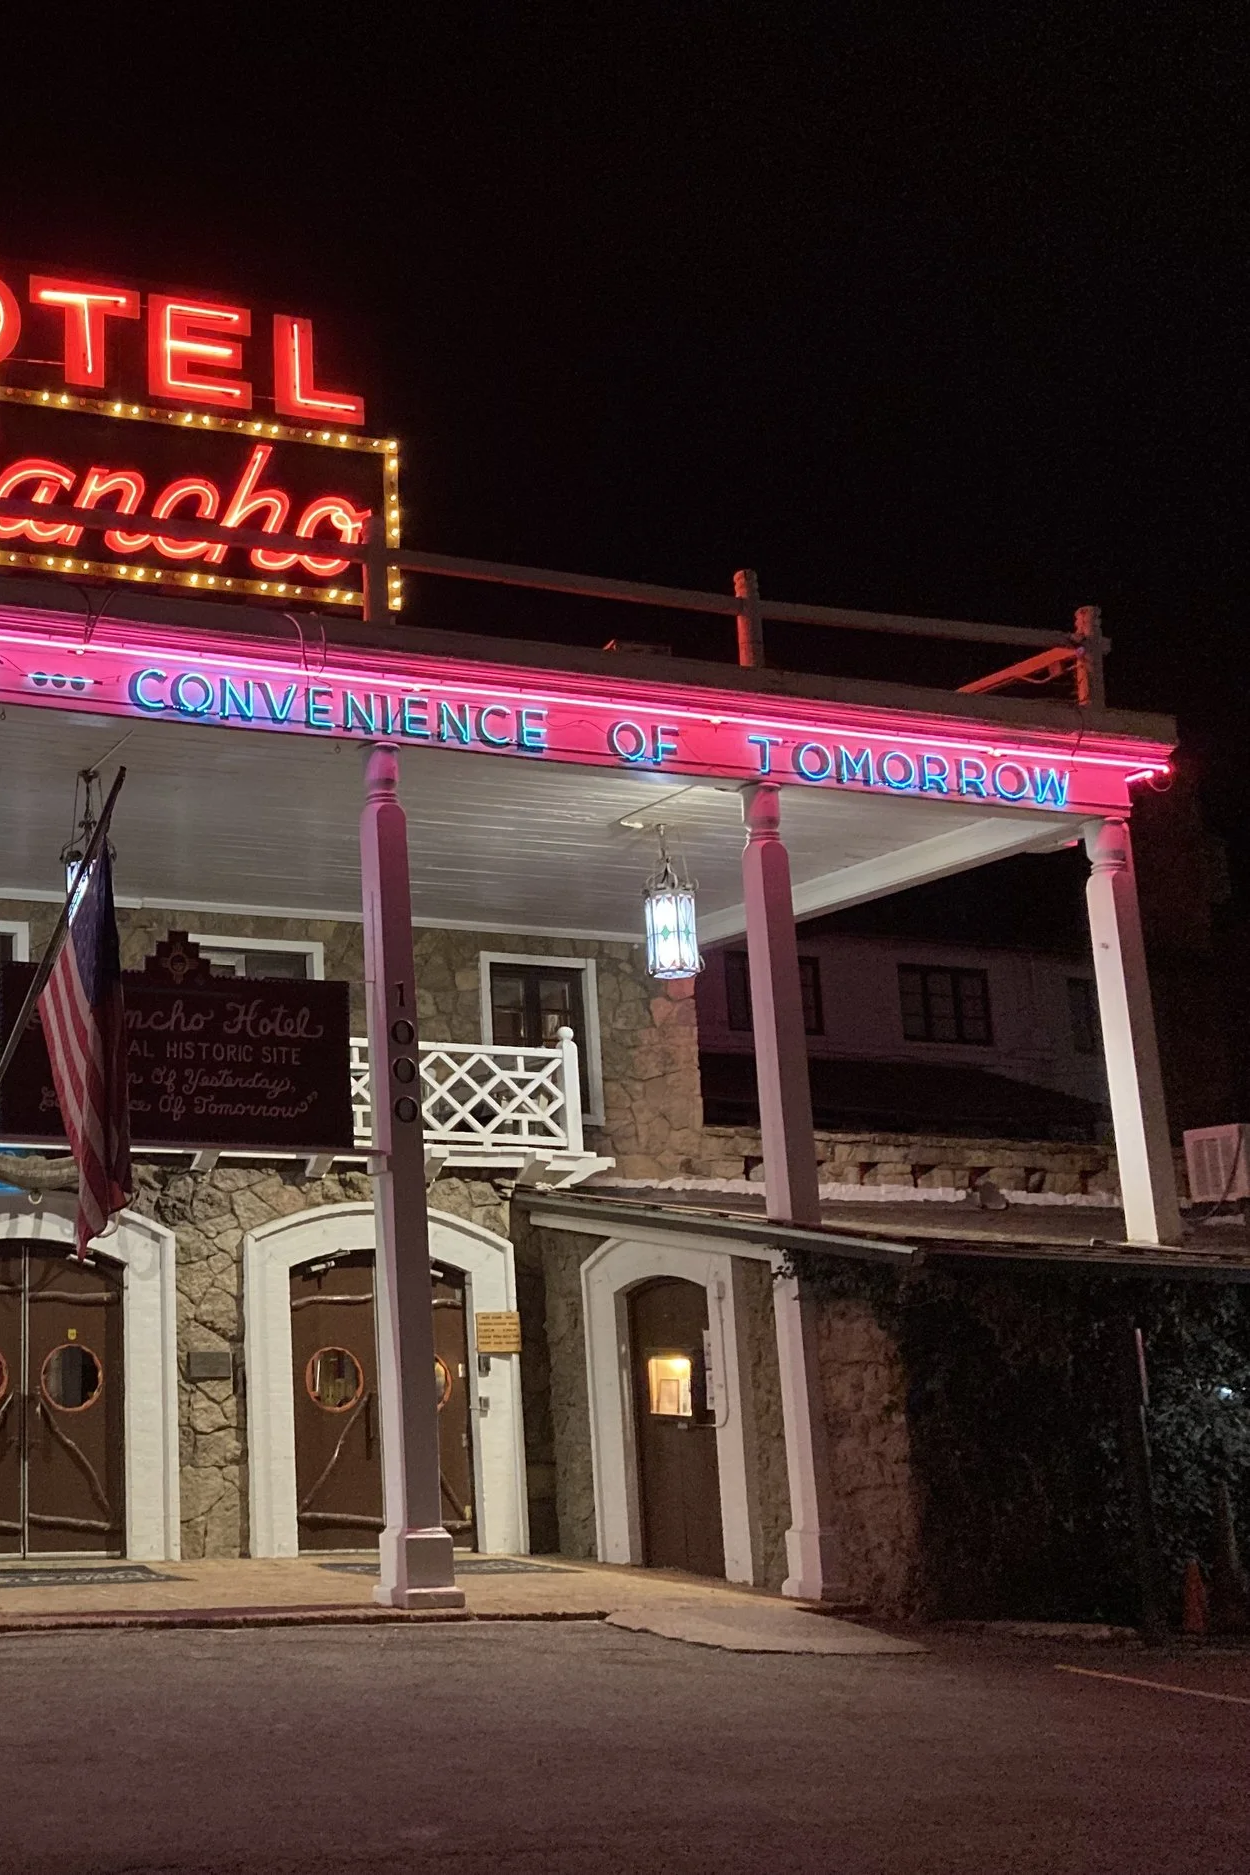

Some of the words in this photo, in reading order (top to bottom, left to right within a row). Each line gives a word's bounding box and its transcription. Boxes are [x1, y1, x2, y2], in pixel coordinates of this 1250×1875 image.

[129, 667, 549, 753] CONVENIENCE
[607, 721, 679, 766] OF
[748, 733, 1072, 808] TOMORROW
[124, 999, 214, 1032] ncho
[223, 1000, 323, 1039] Hotel
[165, 1042, 254, 1063] HISTORIC
[261, 1048, 301, 1064] SITE
[390, 981, 418, 1123] 1000
[151, 1066, 176, 1093] Of
[158, 1093, 186, 1121] Of
